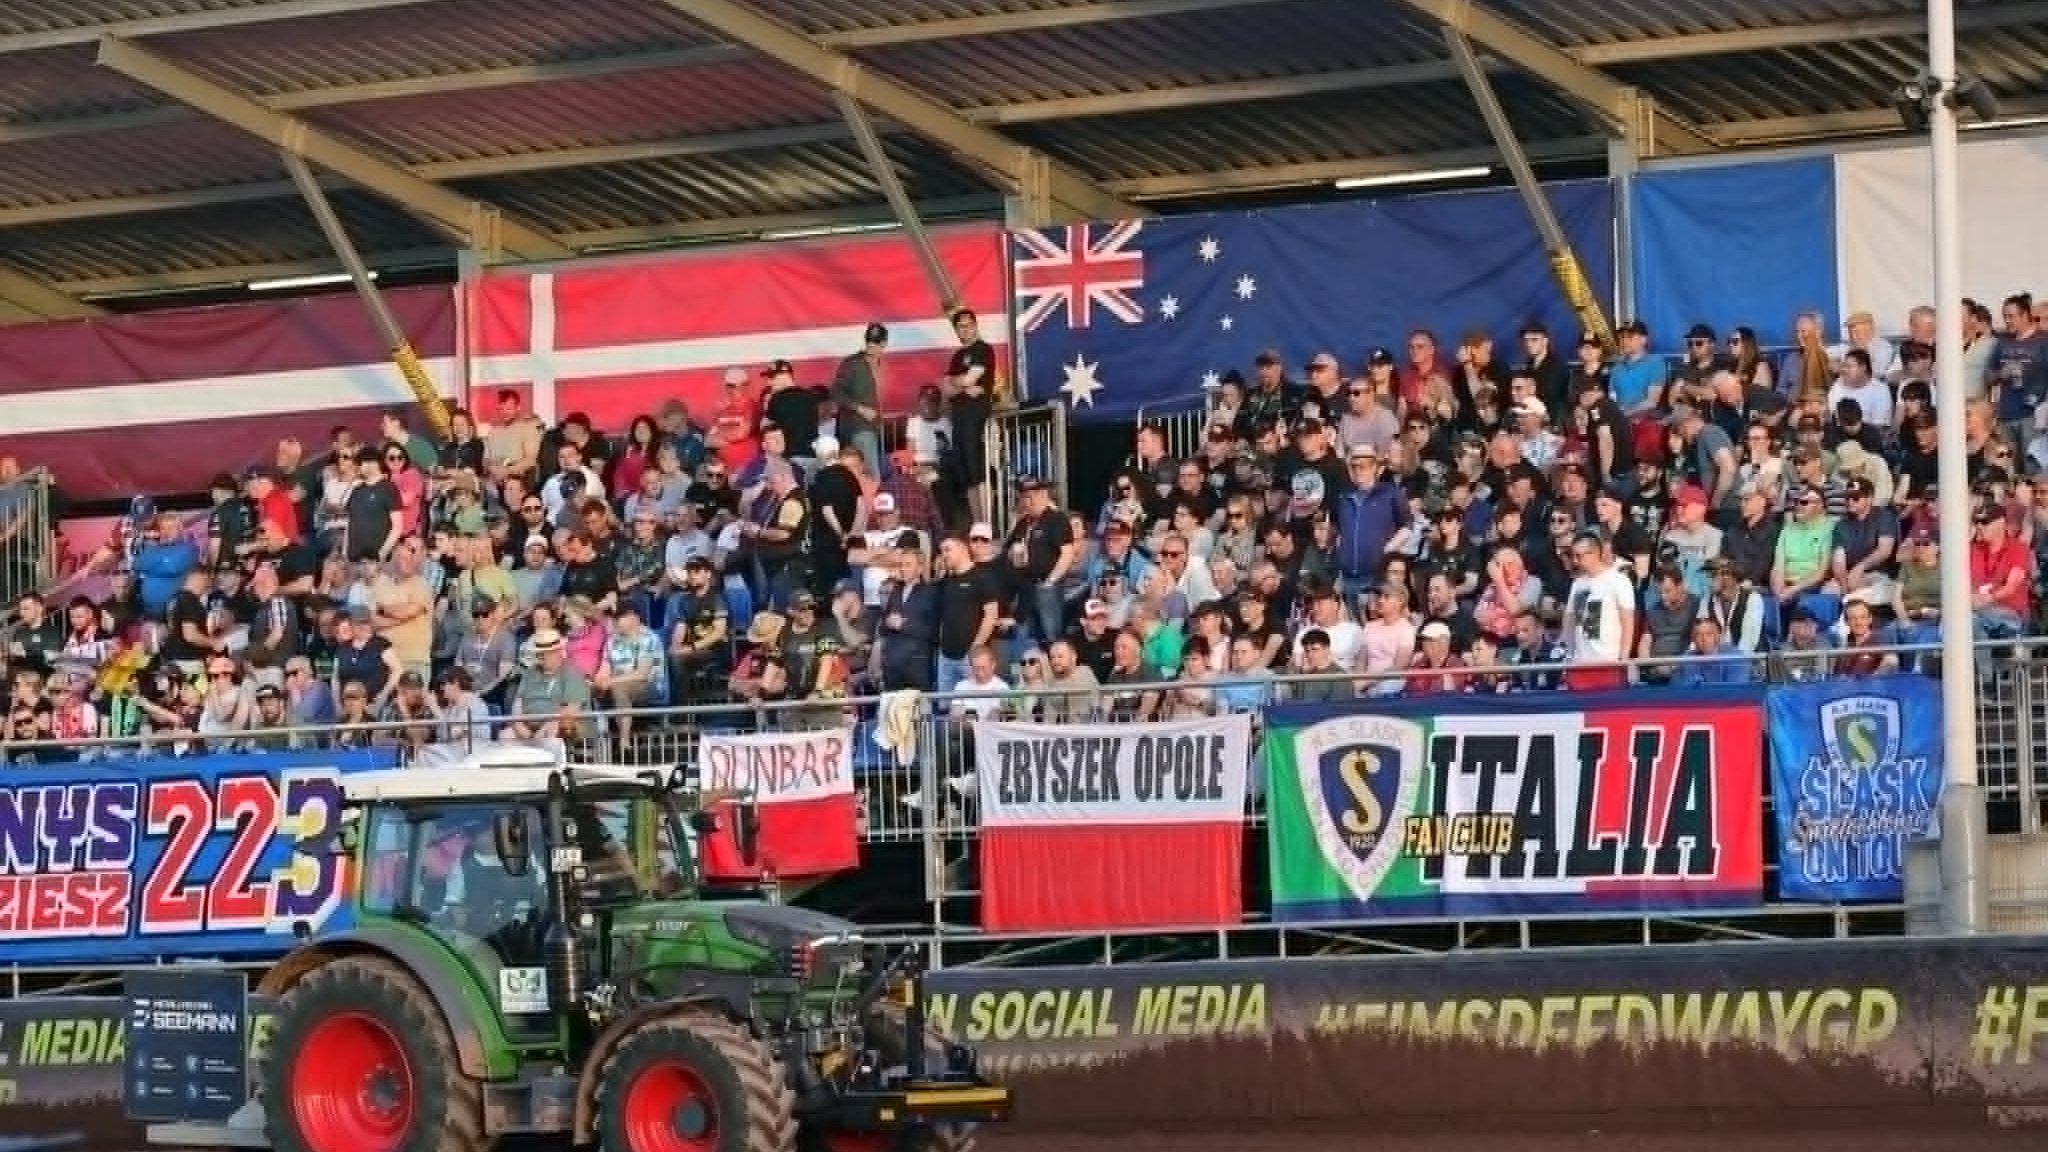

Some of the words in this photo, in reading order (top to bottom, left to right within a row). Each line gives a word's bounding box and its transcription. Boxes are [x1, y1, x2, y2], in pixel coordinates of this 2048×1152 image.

[711, 738, 842, 794] DUNBAR
[998, 737, 1121, 804] ZBYSZEK
[1134, 733, 1225, 802] OPOLE
[1420, 725, 1720, 884] ITALIA
[966, 988, 1119, 1040] SOCIAL
[1131, 984, 1267, 1035] MEDIA
[19, 1018, 125, 1065] MEDIA
